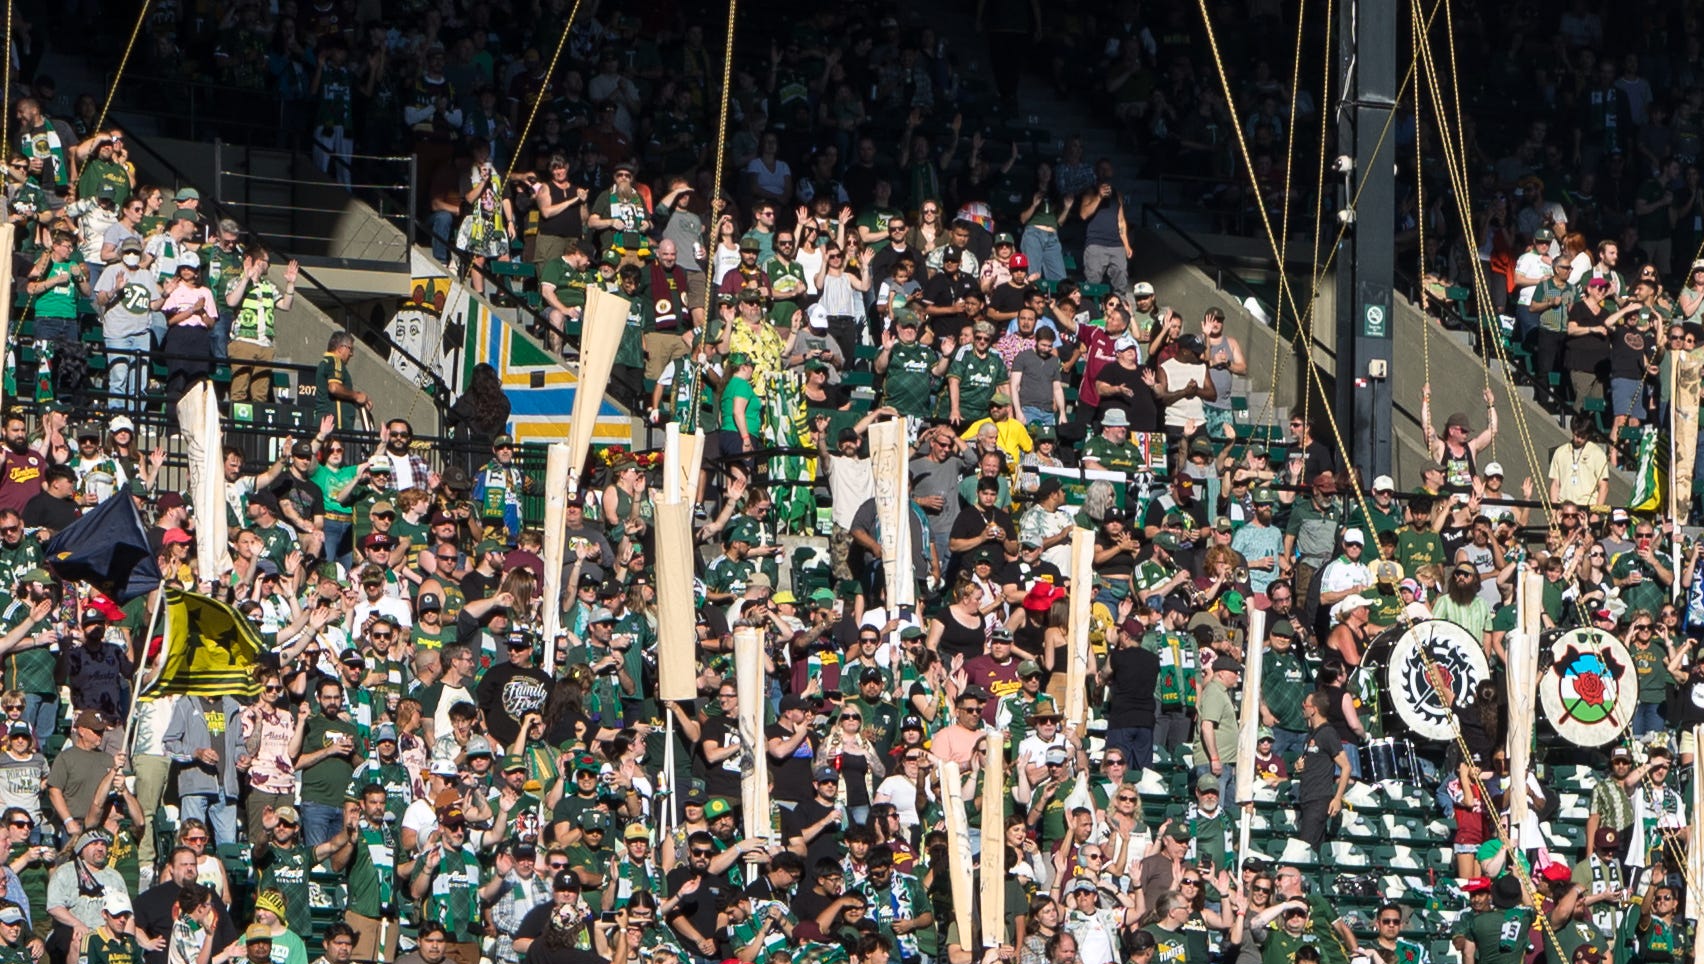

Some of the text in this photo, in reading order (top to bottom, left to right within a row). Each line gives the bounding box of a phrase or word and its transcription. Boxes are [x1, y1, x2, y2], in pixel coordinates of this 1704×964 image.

[298, 384, 318, 396] 207
[503, 681, 549, 703] Family
[274, 866, 305, 878] Alaska
